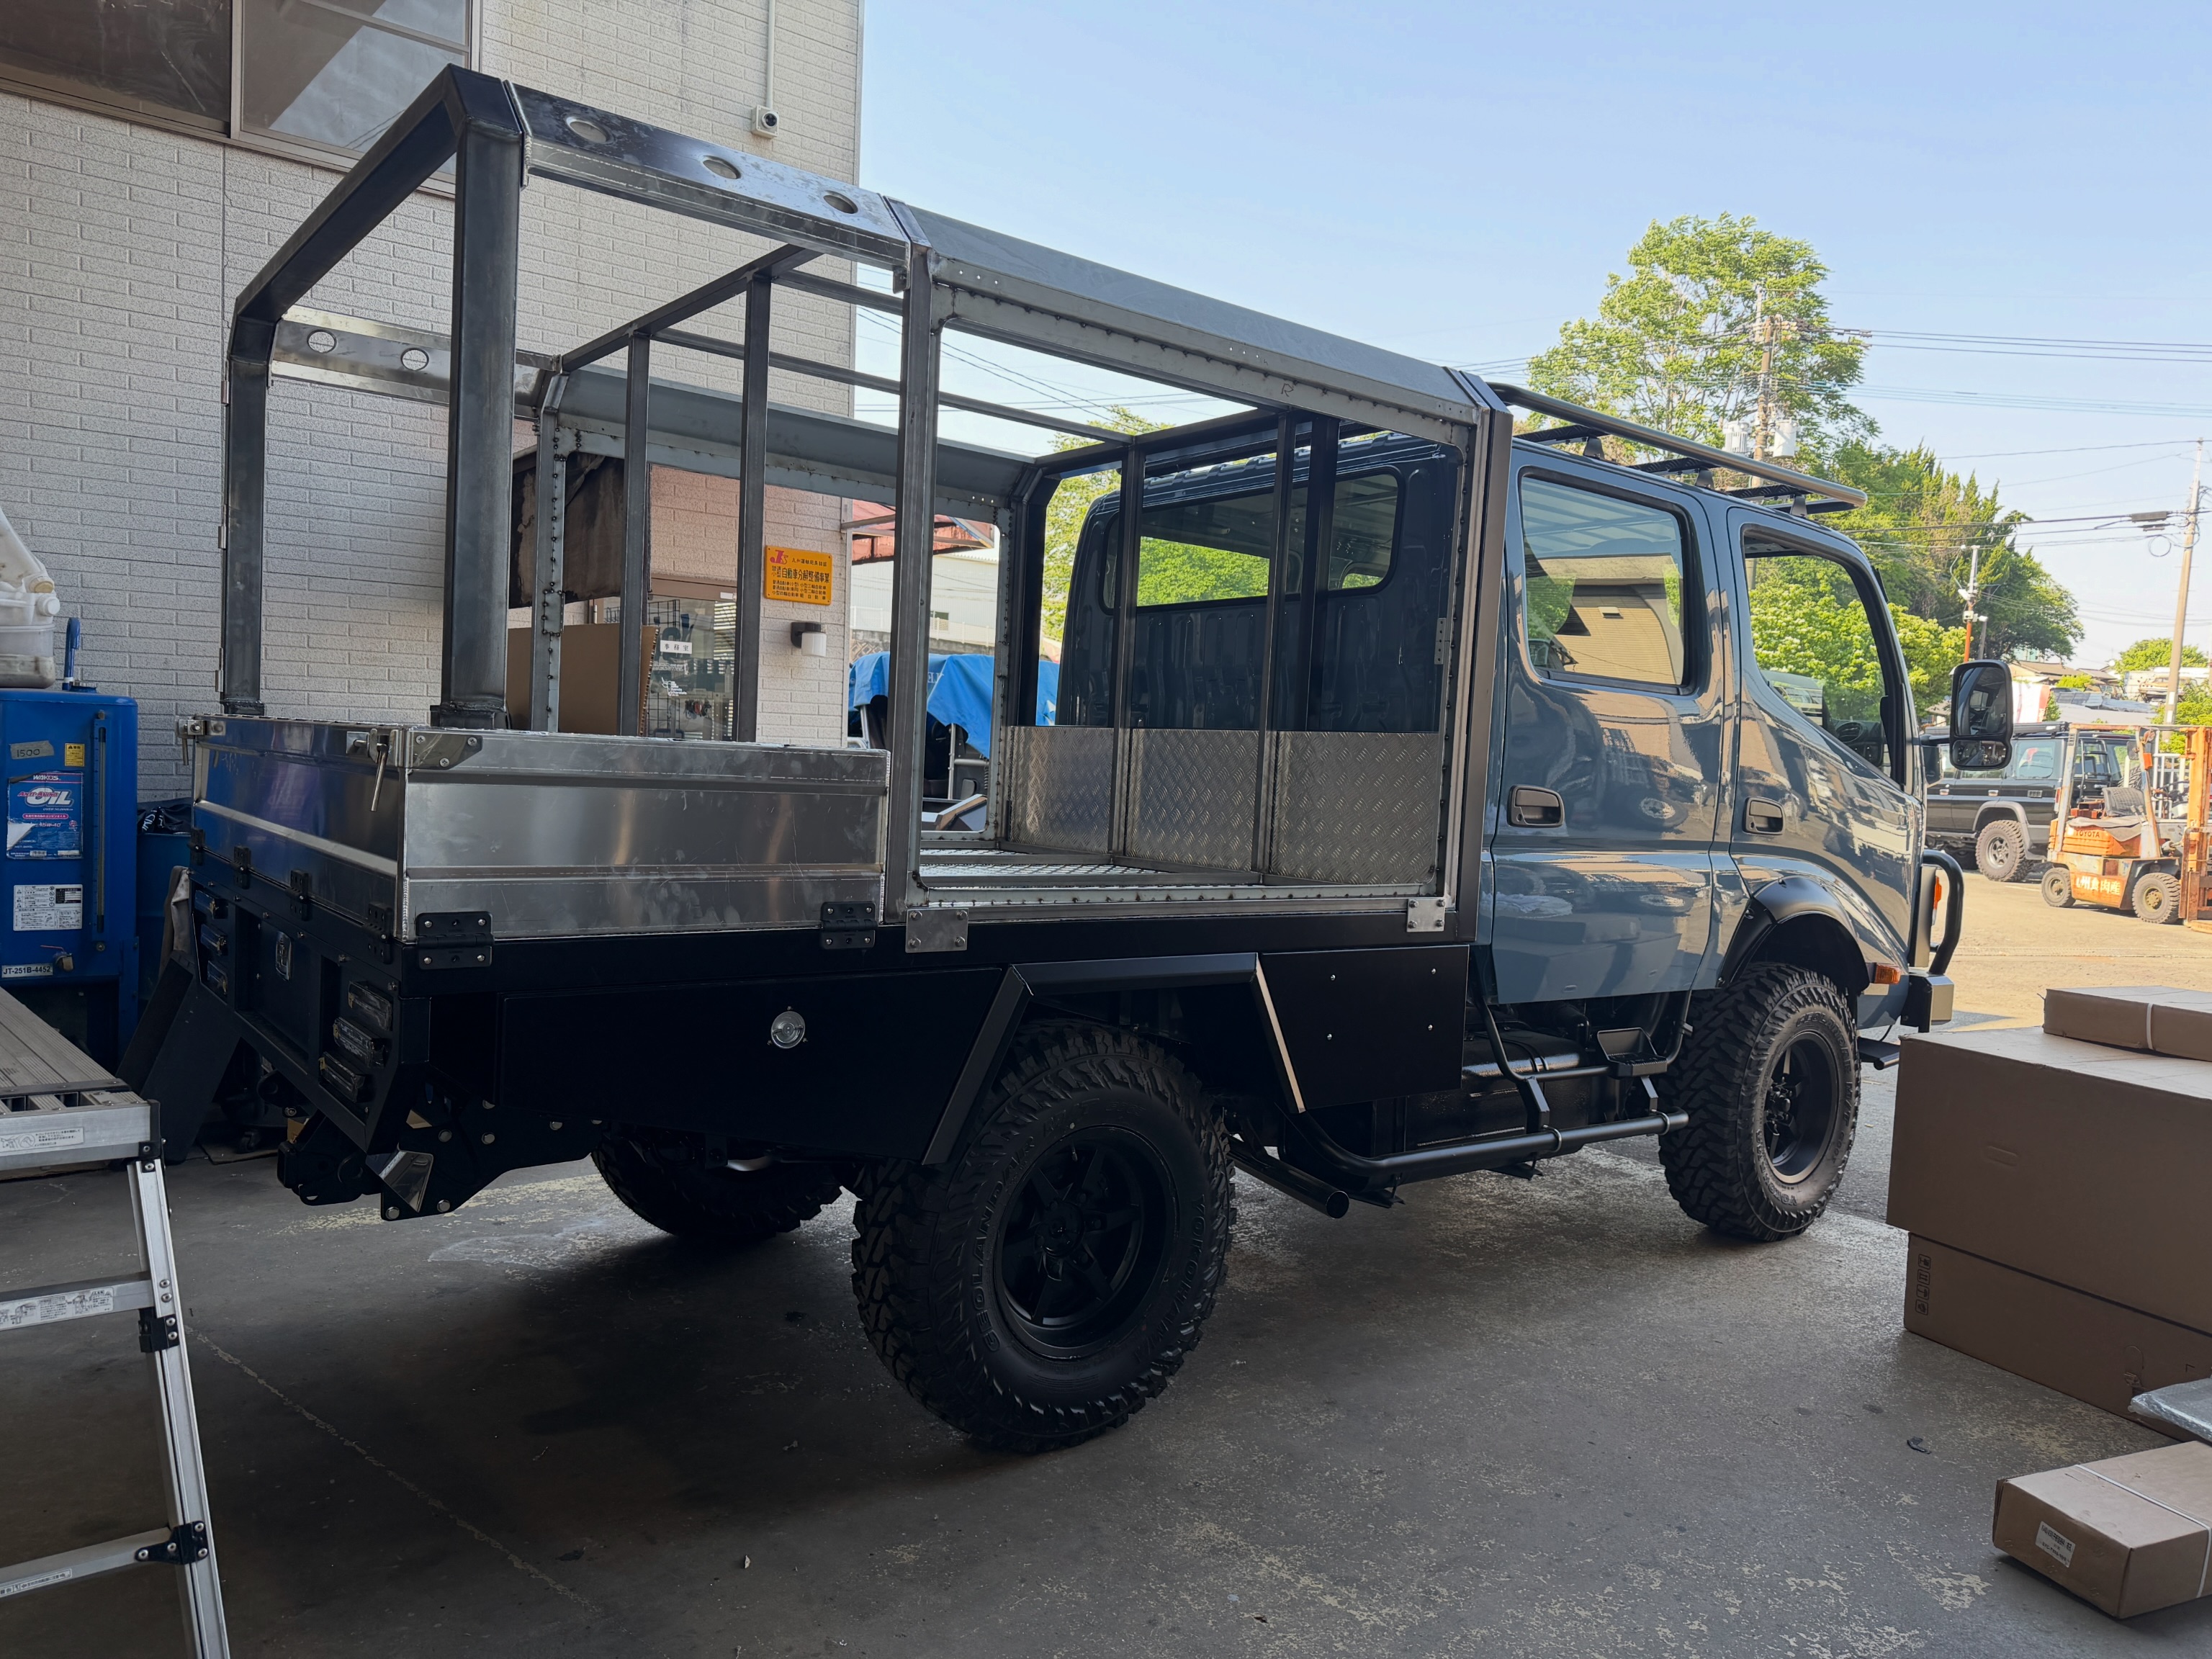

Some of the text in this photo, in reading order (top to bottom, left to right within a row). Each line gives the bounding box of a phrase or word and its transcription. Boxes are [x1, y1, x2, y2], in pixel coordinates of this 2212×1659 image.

[782, 567, 830, 583] 自動車分解整備事業
[665, 643, 689, 652] 事務室
[17, 748, 40, 757] 1500
[26, 786, 71, 806] OIL
[3, 966, 51, 975] JT-251B-4452
